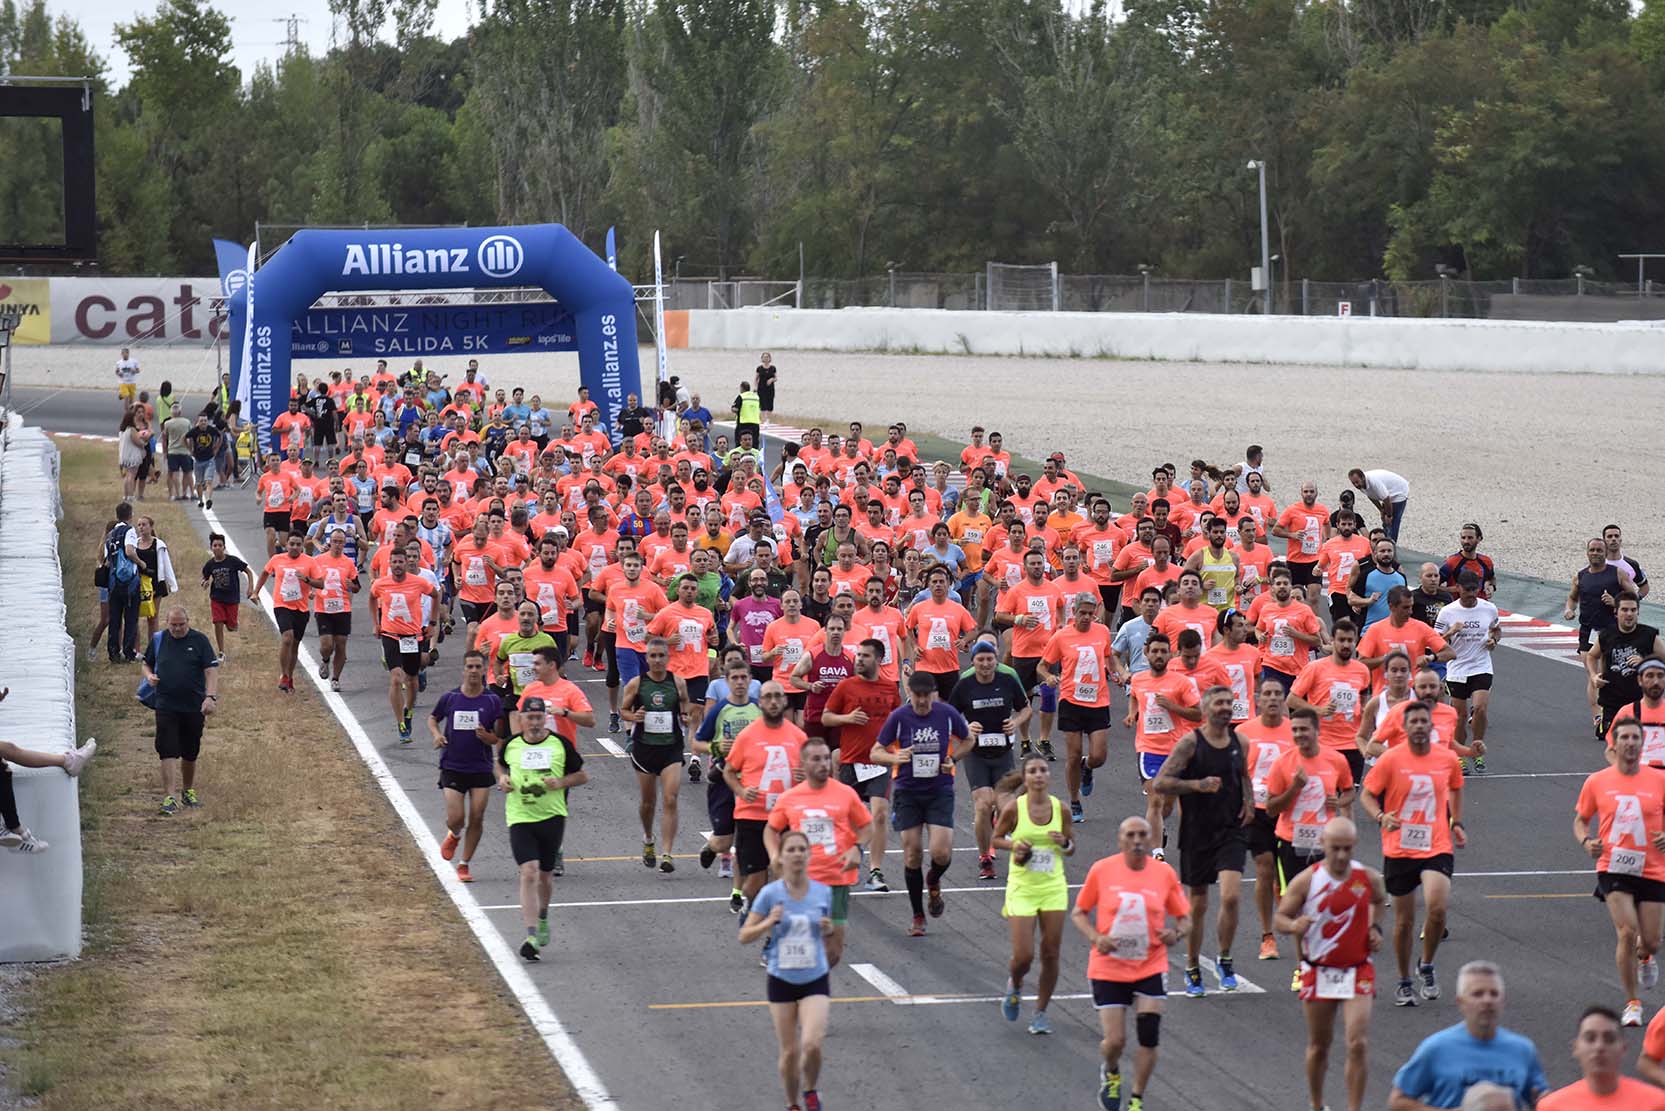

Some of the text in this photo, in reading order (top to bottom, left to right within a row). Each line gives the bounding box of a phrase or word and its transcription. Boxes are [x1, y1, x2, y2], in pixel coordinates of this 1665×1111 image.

[342, 243, 470, 275] Allianz
[291, 313, 409, 334] ALLIANZ
[422, 310, 508, 332] NIGHT
[291, 342, 317, 352] llianz
[375, 336, 455, 352] SALIDA
[463, 334, 489, 350] 5K
[601, 314, 624, 447] www.allianz.es
[633, 520, 644, 528] 50
[1463, 621, 1480, 629] SGS
[933, 635, 946, 643] 584
[819, 666, 848, 676] GAVÀ
[1079, 687, 1094, 695] 667
[1336, 692, 1352, 700] 610
[459, 715, 474, 723] 724
[653, 716, 665, 724] 76
[1148, 717, 1163, 725] 572
[983, 738, 999, 746] 633
[526, 752, 543, 760] 276
[917, 759, 935, 768] 347
[807, 823, 824, 833] 238
[1297, 829, 1316, 838] 555
[1407, 829, 1426, 839] 723
[1032, 854, 1050, 864] 239
[1616, 854, 1635, 866] 200
